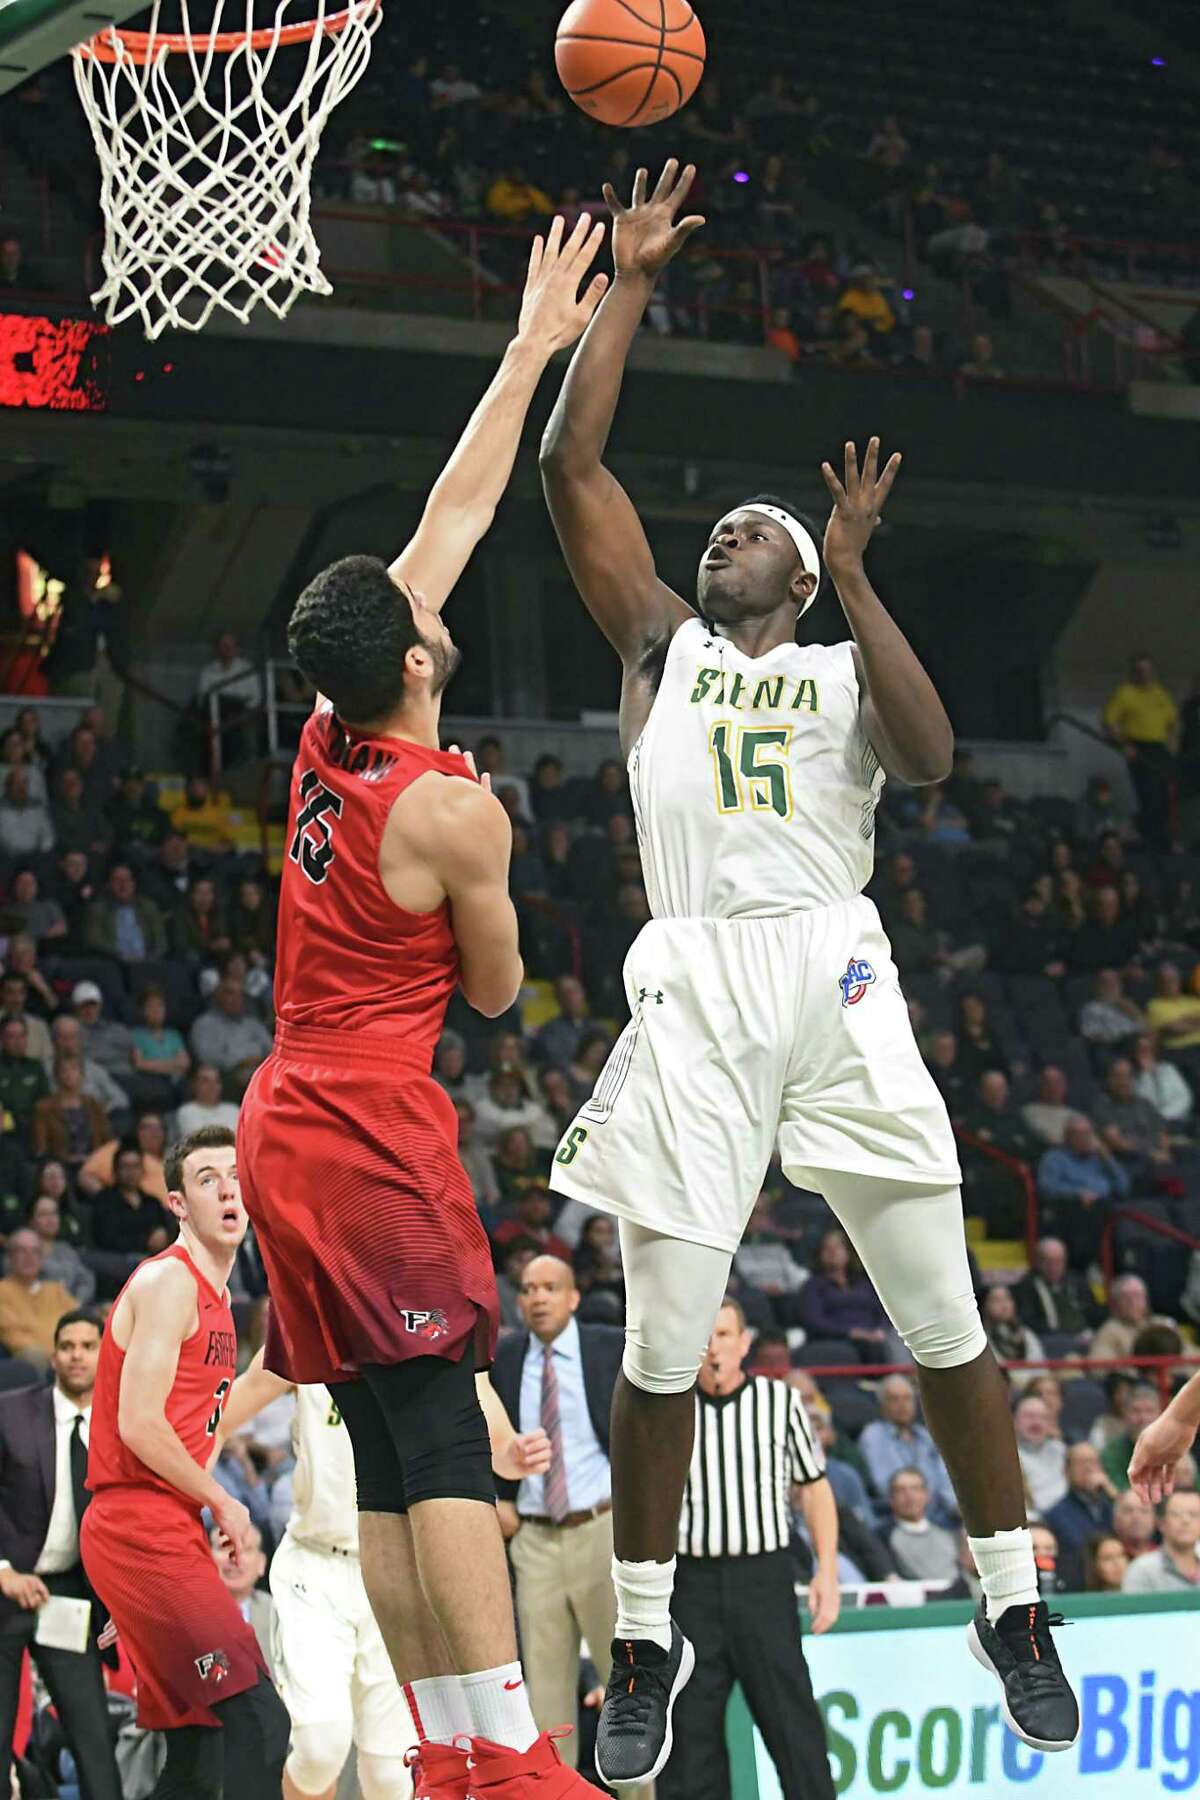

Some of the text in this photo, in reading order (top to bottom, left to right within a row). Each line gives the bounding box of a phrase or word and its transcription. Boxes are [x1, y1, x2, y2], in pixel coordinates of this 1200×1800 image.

[708, 720, 794, 822] 15
[288, 768, 344, 885] 15
[554, 1125, 588, 1167] S
[400, 1310, 430, 1332] F
[1078, 1670, 1200, 1792] Big
